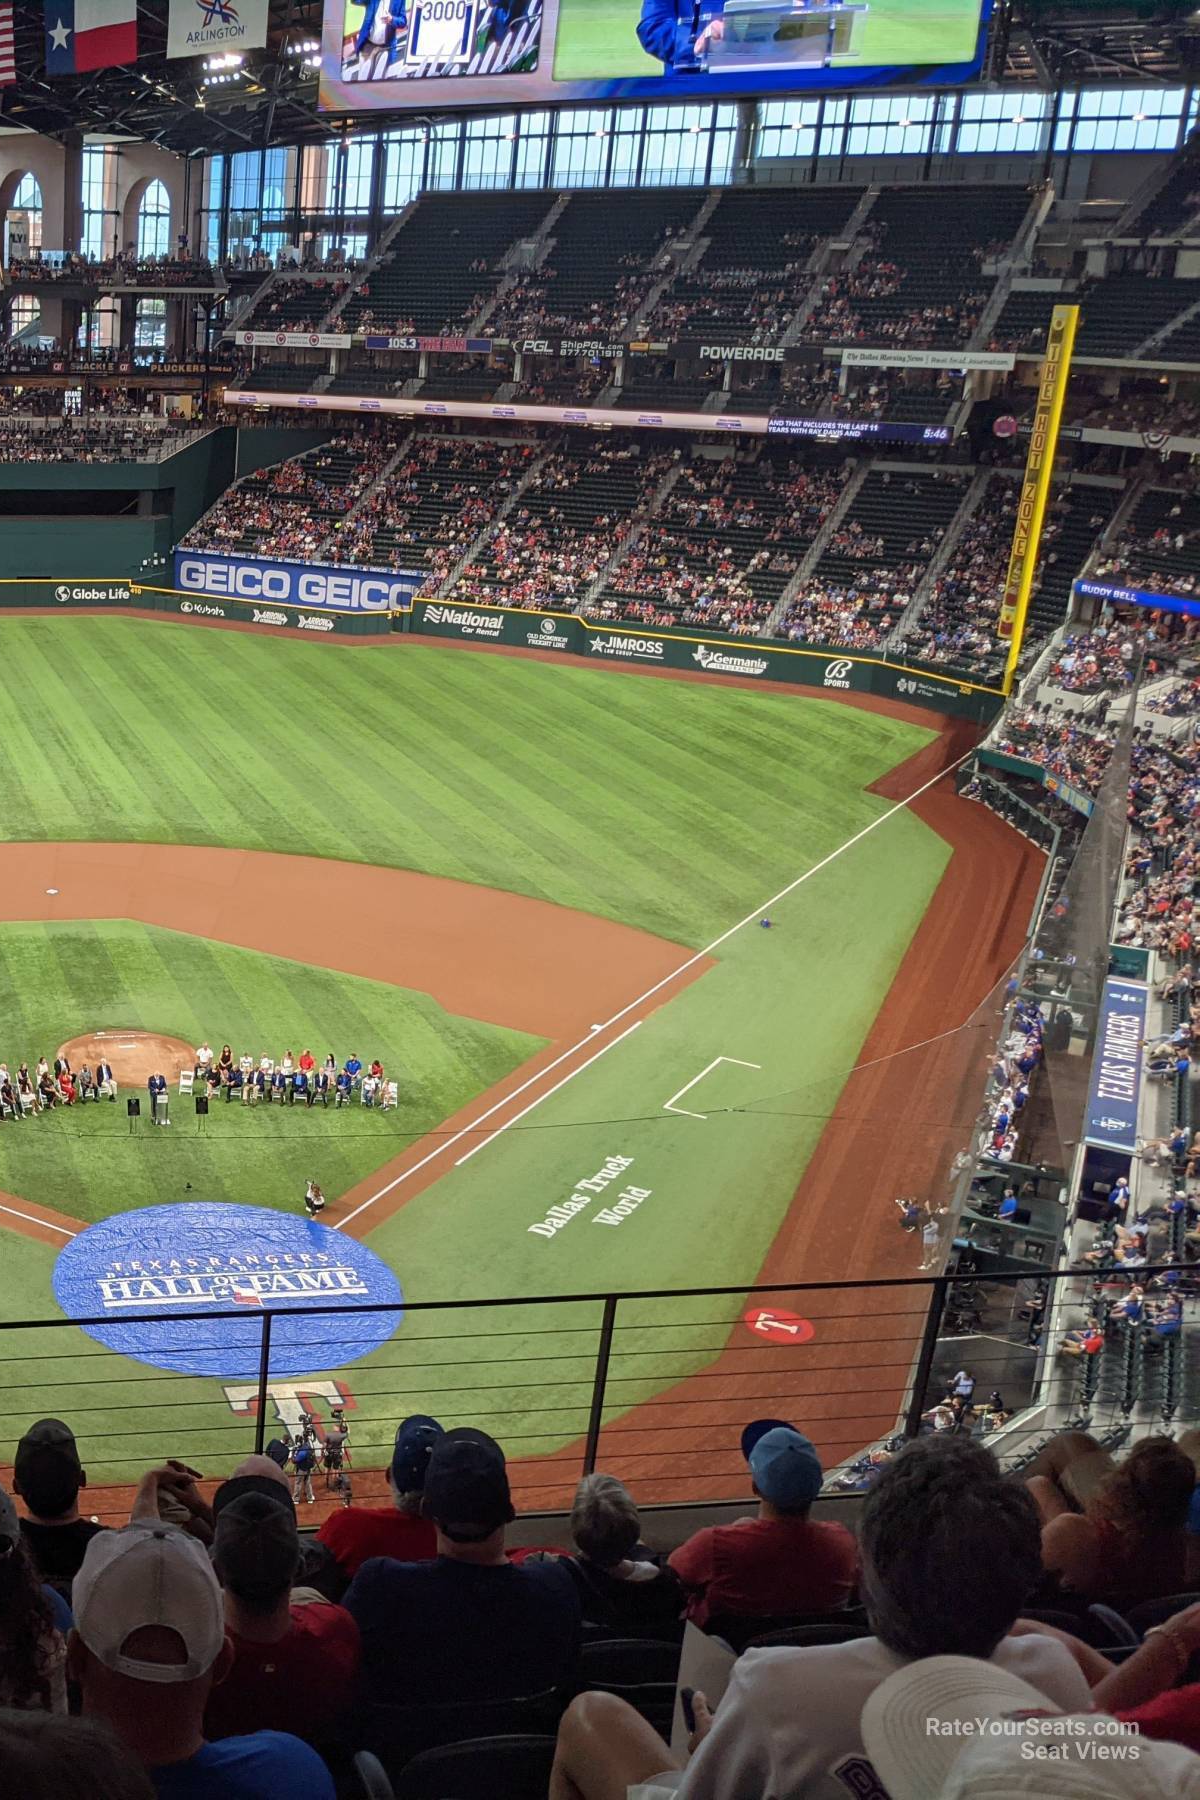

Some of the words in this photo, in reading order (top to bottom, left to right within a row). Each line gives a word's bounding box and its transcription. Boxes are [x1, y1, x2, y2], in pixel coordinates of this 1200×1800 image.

[422, 1, 466, 20] 3000
[186, 25, 246, 43] ARLINGTON
[388, 338, 416, 349] 105.3
[522, 340, 554, 352] PGL
[560, 340, 624, 350] ShipPGL.com
[700, 347, 785, 361] POWERADE
[151, 364, 207, 373] PLUCKERS
[768, 426, 789, 434] YEARS
[803, 421, 836, 429] INCLUDES
[837, 422, 850, 430] THE
[852, 423, 869, 431] LAST
[923, 429, 947, 439] 5:46
[1030, 414, 1047, 469] HOT
[1015, 484, 1036, 555] ZONE
[180, 559, 291, 600] GEICO
[73, 588, 107, 600] Globe
[108, 588, 130, 600] Life
[1081, 584, 1112, 596] BUDDY
[1113, 590, 1137, 602] BELL
[194, 604, 225, 616] Kubota
[442, 609, 504, 629] National
[462, 626, 475, 634] Car
[476, 628, 500, 637] Rental
[527, 633, 539, 641] OLD
[539, 634, 568, 643] DOMINION
[714, 652, 768, 670] Germania
[823, 678, 850, 689] SPORTS
[1103, 1011, 1140, 1062] RANGERS
[1097, 1062, 1136, 1102] TEXAS
[527, 1193, 592, 1239] Dallas
[574, 1154, 635, 1193] Truck
[591, 1185, 653, 1226] World
[111, 1257, 198, 1272] TEXAS
[209, 1252, 330, 1267] RANGERS
[100, 1276, 213, 1301] HALL
[213, 1275, 241, 1287] OF
[249, 1270, 365, 1293] FAME
